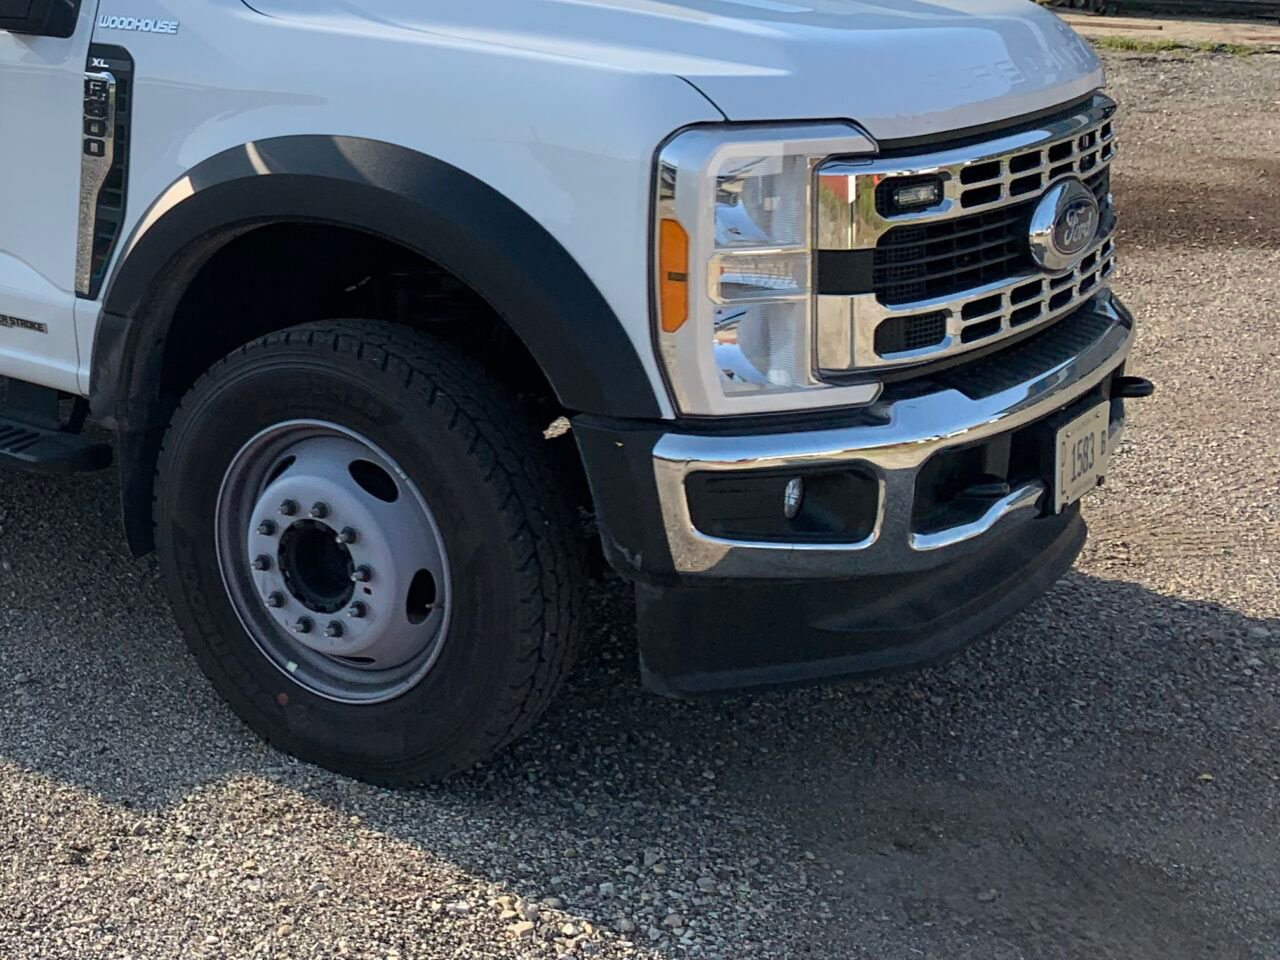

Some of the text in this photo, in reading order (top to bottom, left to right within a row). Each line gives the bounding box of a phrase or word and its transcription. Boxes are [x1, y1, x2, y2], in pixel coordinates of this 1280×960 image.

[98, 15, 180, 34] WOODHOUSE
[91, 58, 109, 67] XL
[1064, 207, 1093, 246] Ford
[9, 316, 45, 332] STROKE
[1071, 432, 1095, 482] 1583
